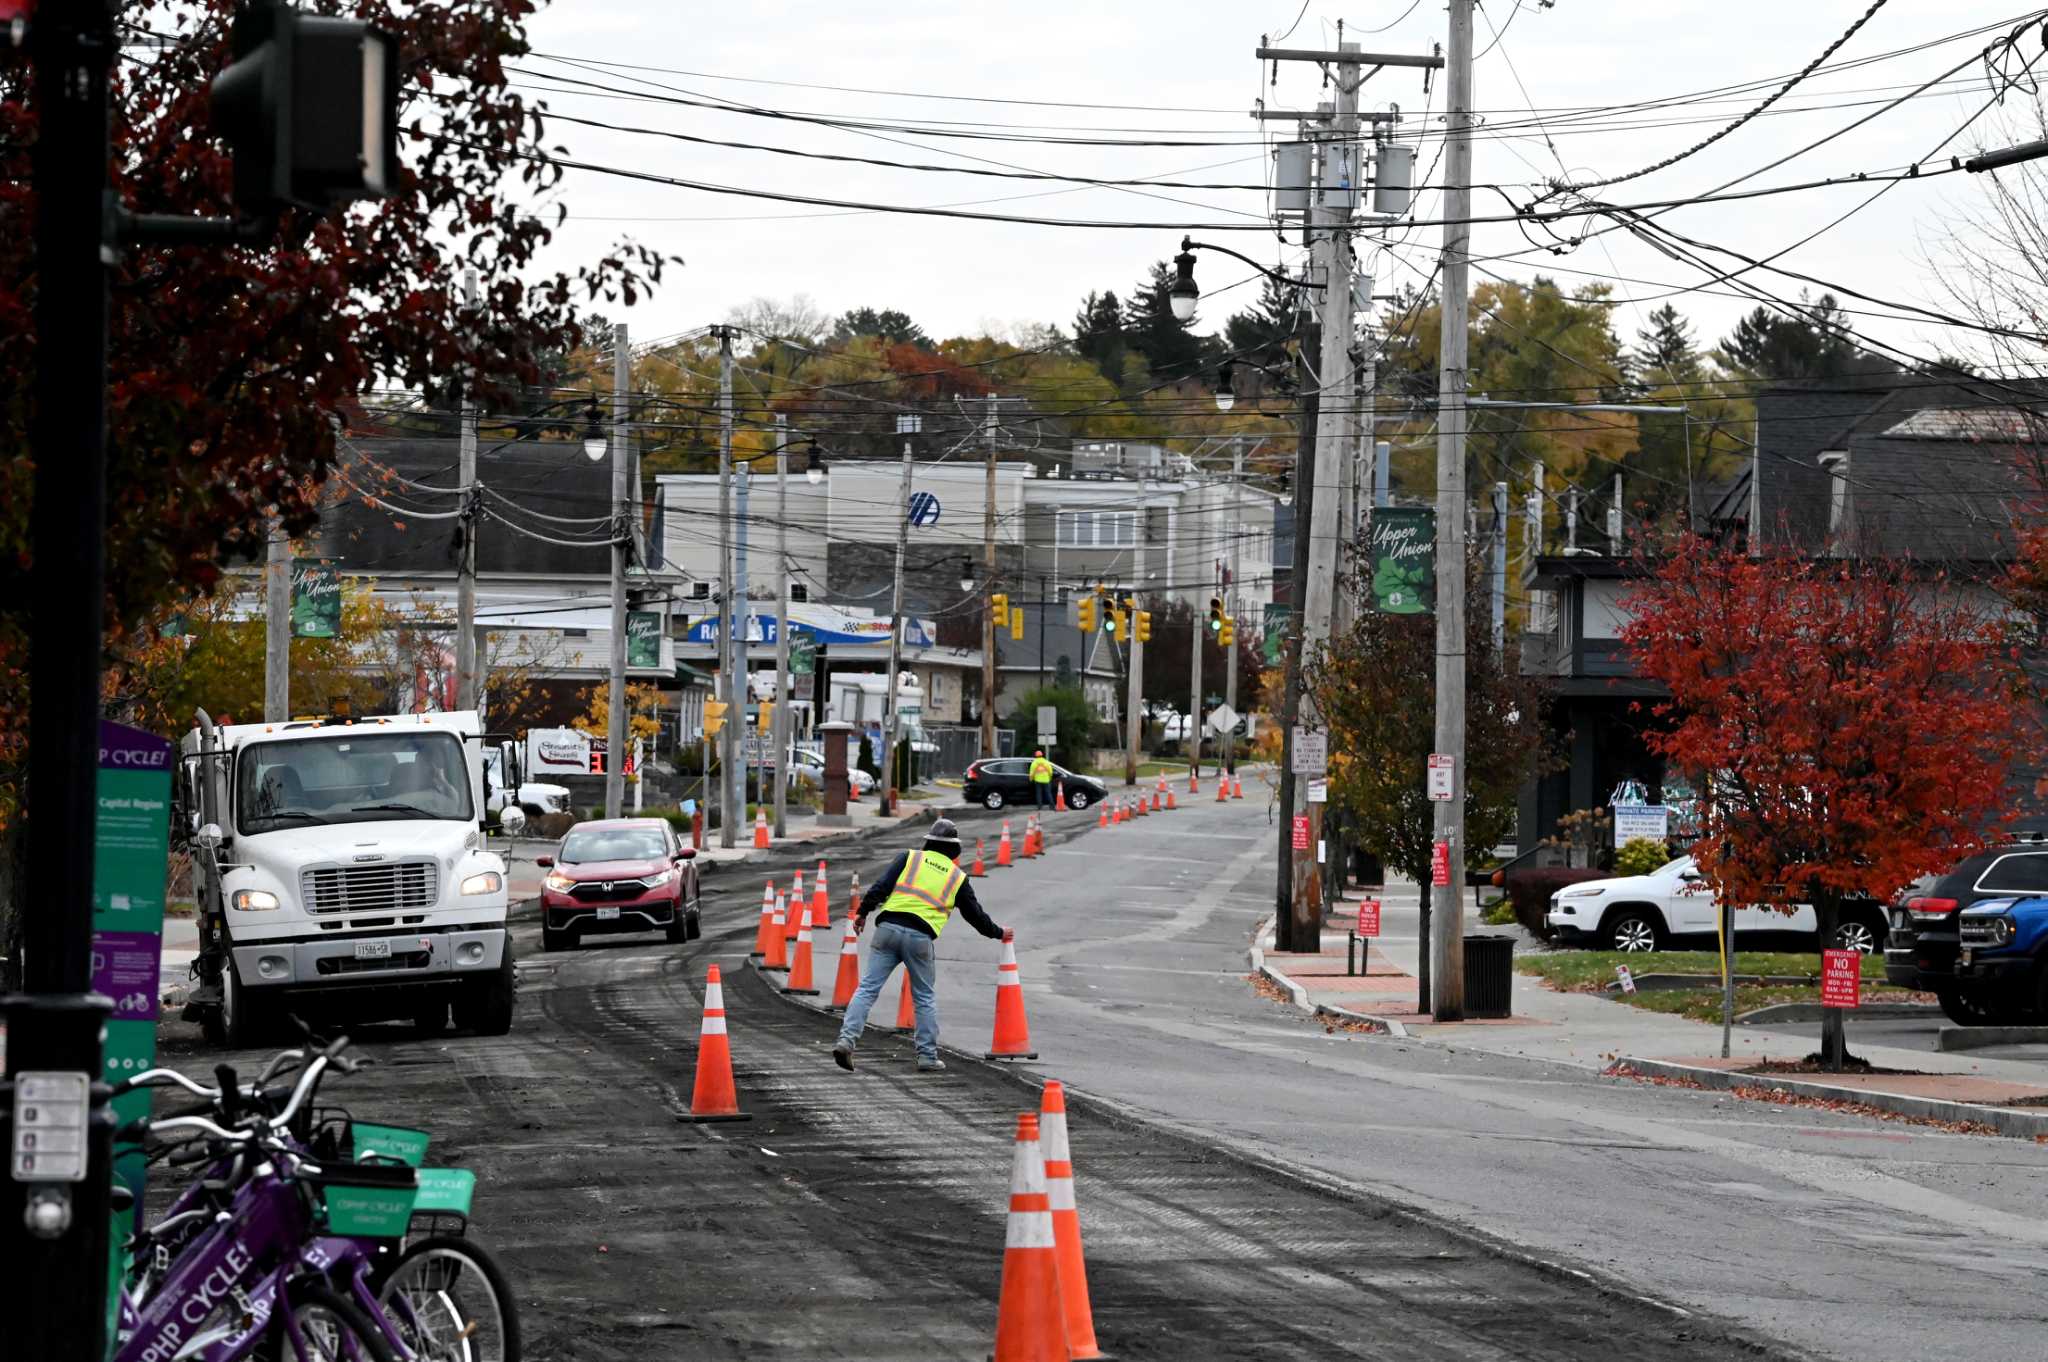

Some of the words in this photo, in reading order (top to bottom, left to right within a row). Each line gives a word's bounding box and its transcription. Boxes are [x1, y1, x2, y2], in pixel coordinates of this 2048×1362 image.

[1373, 522, 1418, 550] Upper
[1391, 538, 1434, 560] Union
[305, 580, 340, 597] Union
[112, 750, 167, 765] CYCLE!
[1824, 950, 1857, 958] EMERGENCY
[1833, 958, 1849, 970] NO
[1826, 969, 1855, 979] PARKING
[182, 1240, 252, 1325] CYCLE!
